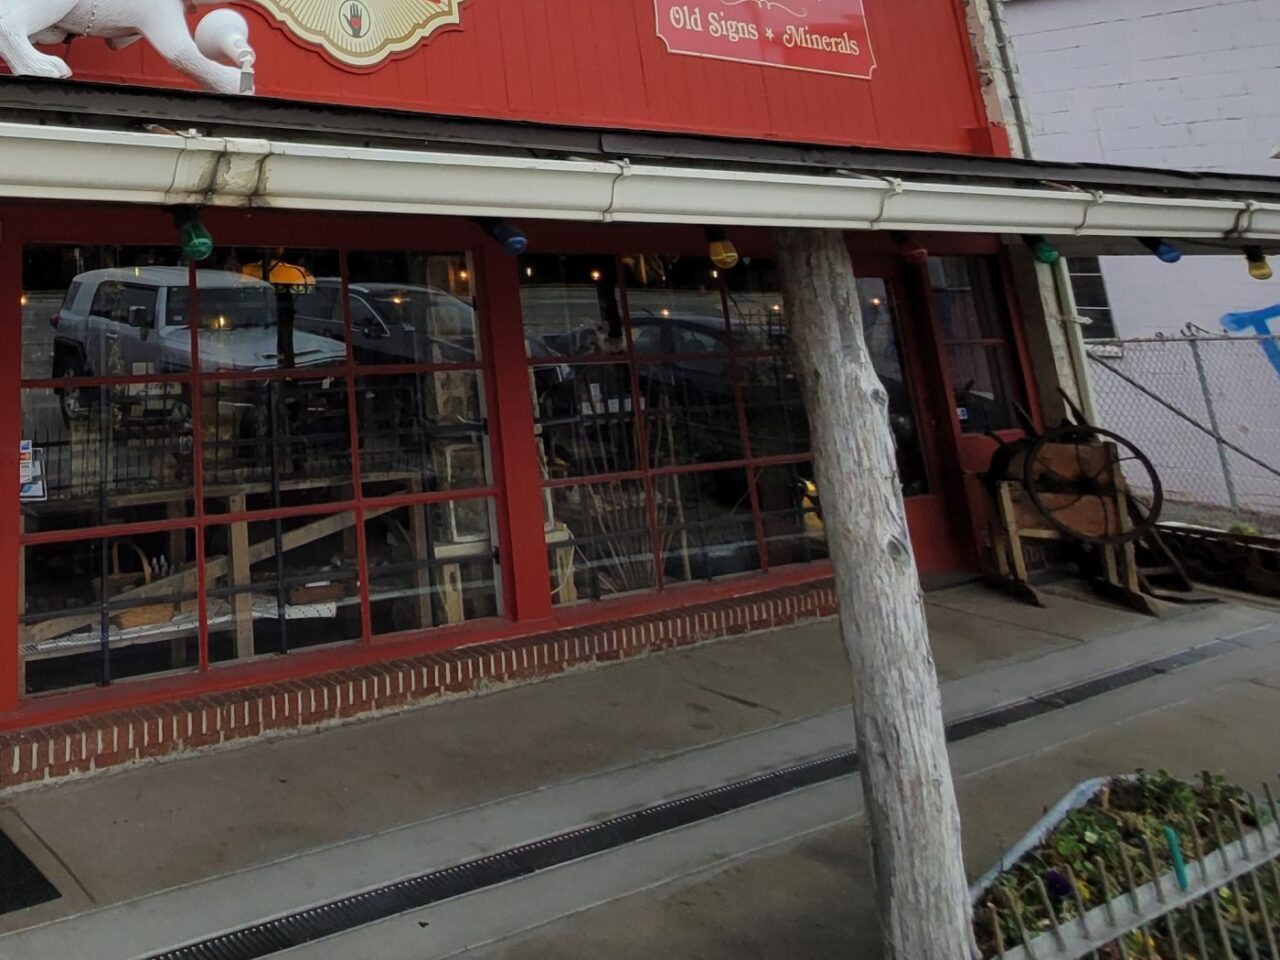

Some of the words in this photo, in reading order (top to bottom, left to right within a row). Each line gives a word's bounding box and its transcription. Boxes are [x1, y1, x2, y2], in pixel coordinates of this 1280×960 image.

[670, 5, 703, 32] Old
[709, 11, 758, 41] Signs
[783, 25, 860, 55] Minerals
